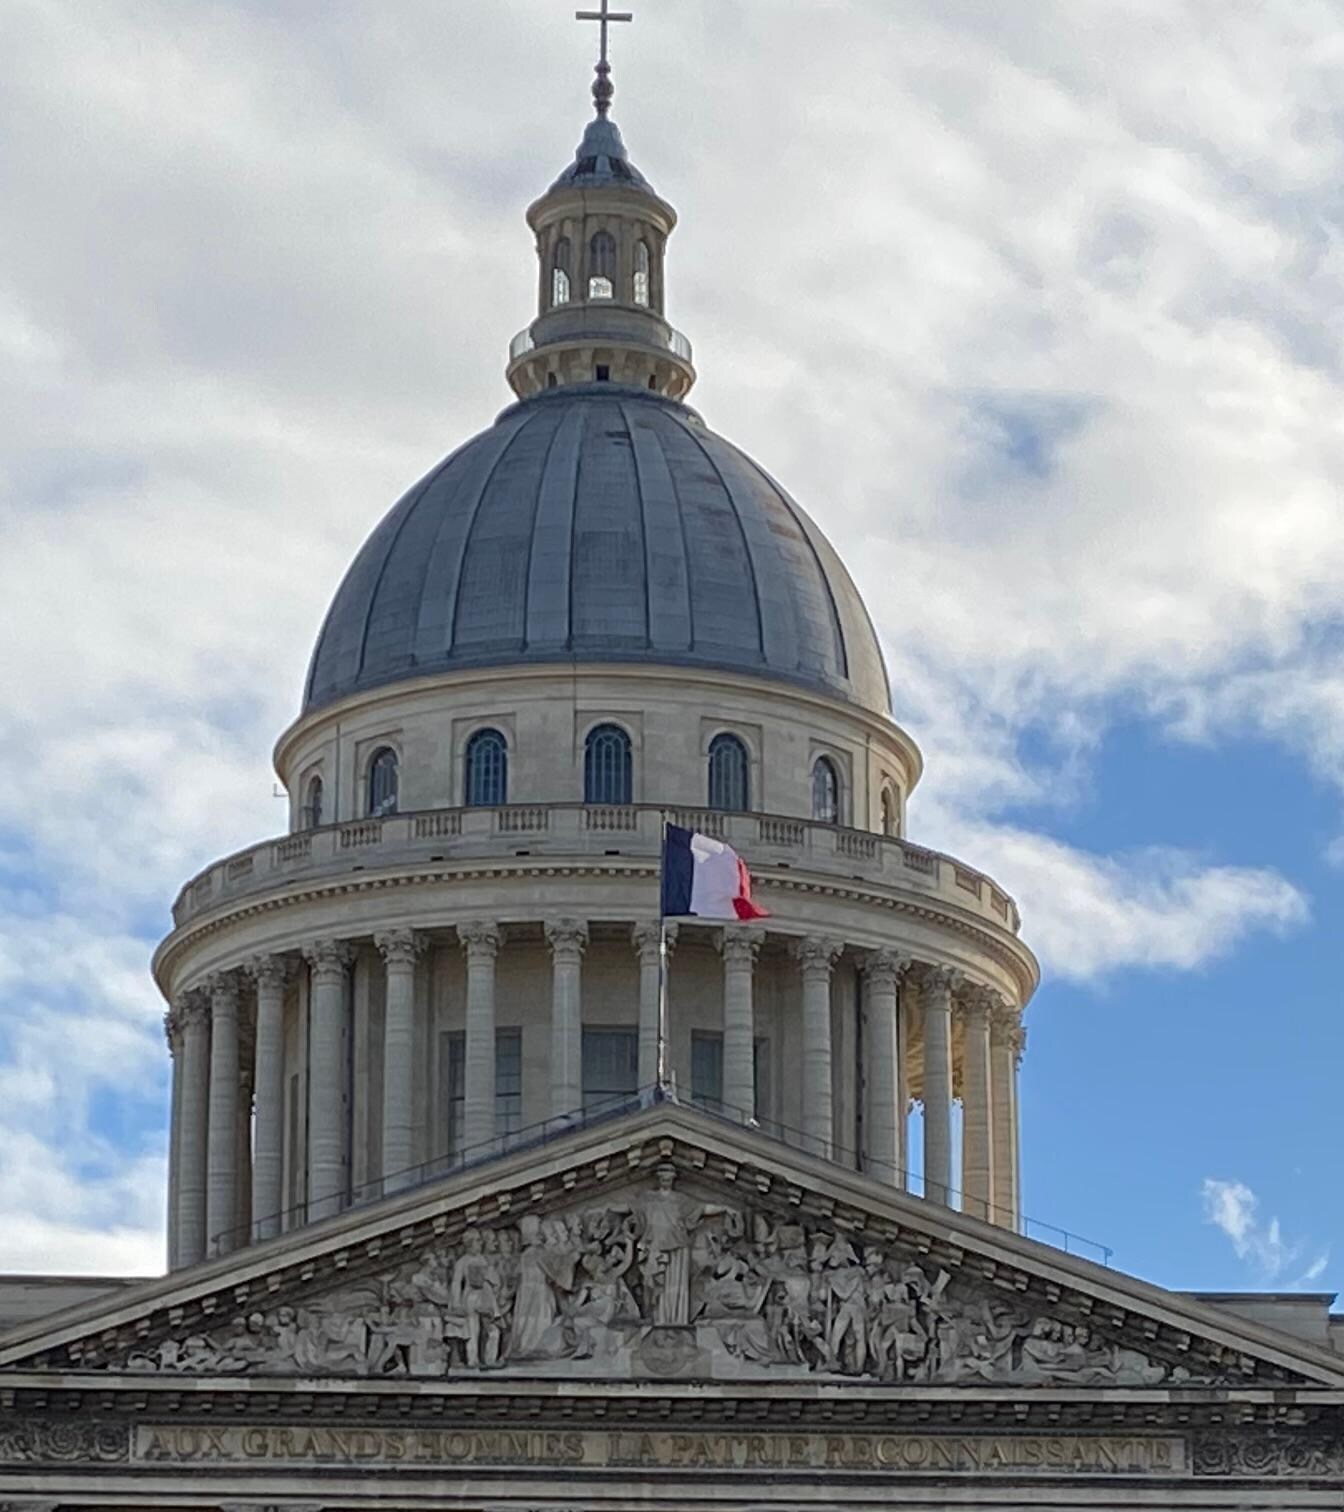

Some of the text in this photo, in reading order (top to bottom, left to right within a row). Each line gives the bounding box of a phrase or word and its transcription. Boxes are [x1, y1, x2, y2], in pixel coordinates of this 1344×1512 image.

[144, 1427, 1171, 1471] AUX GRANDS HOMMES LA PATRIE RECONNAISSANTE
